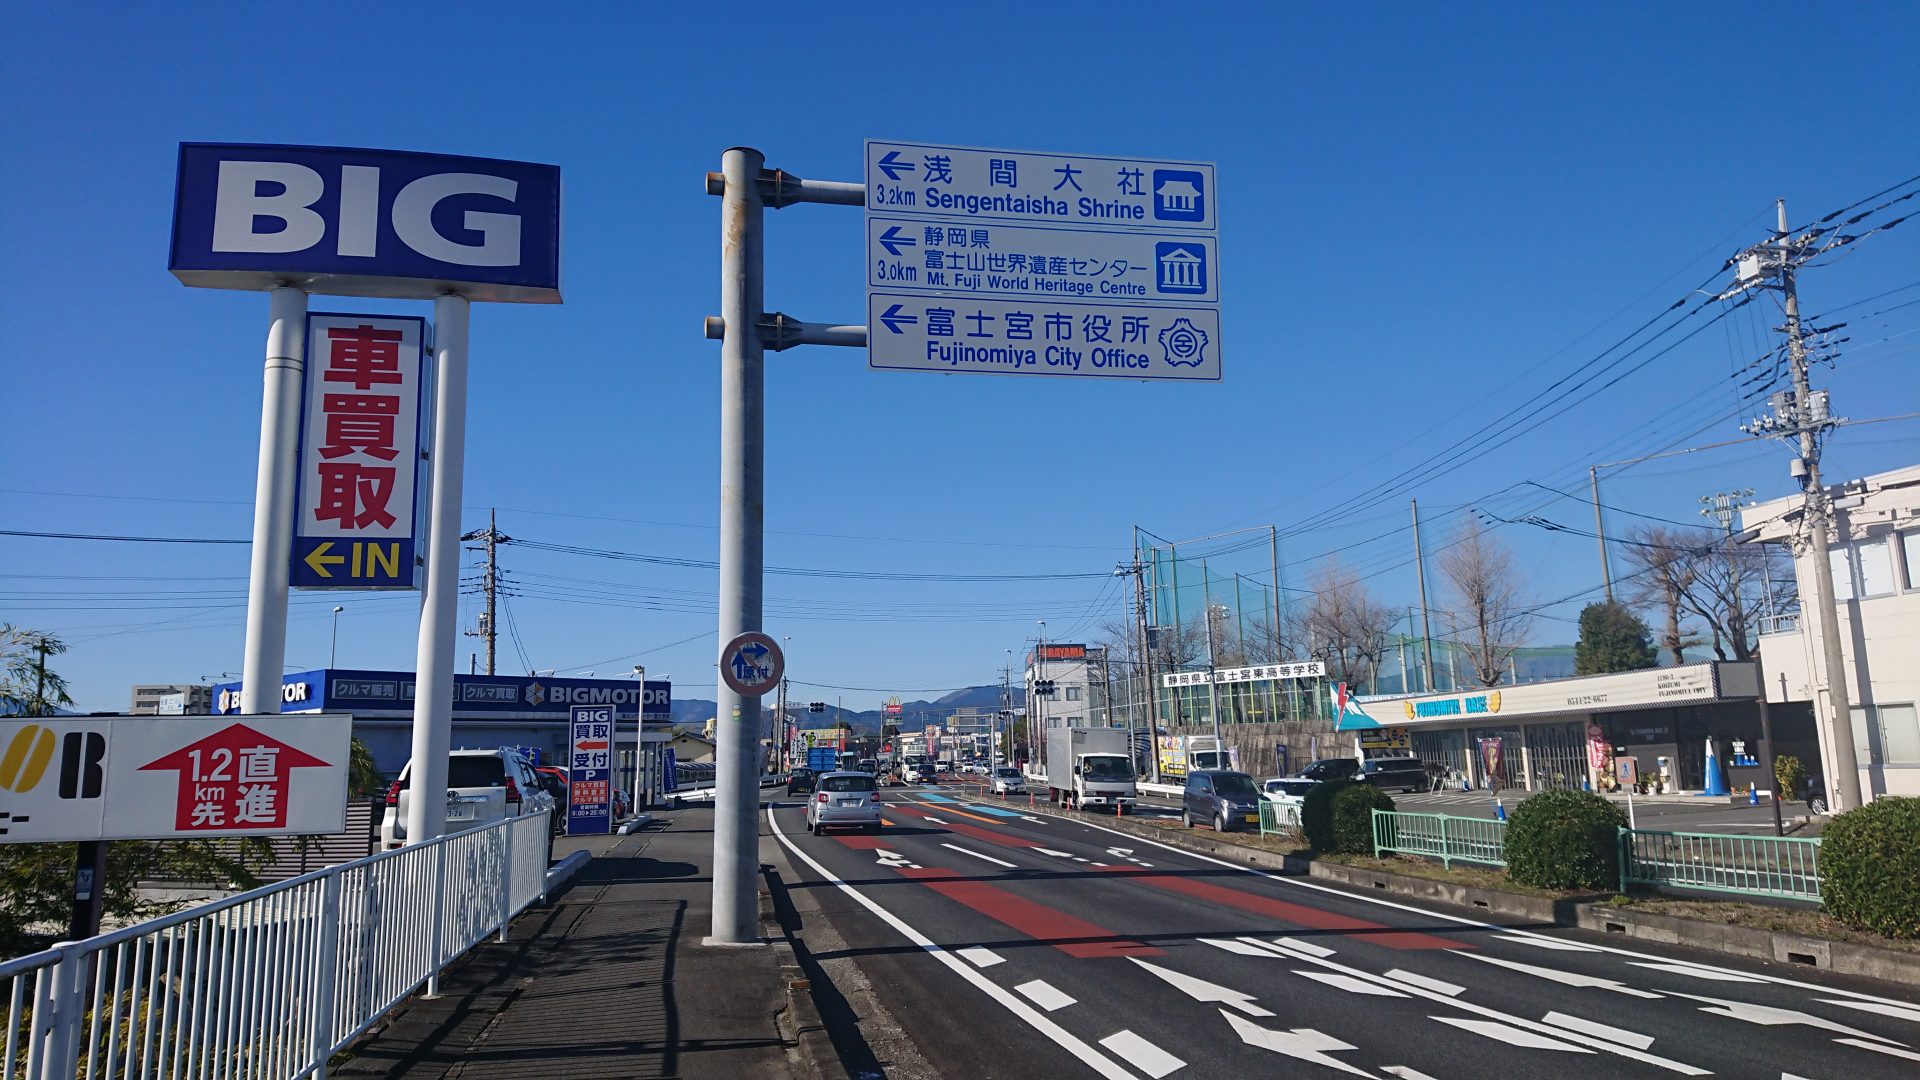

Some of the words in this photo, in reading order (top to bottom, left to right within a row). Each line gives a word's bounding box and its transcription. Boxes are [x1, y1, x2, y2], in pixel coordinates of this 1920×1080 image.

[923, 154, 1146, 196] 浅間大社
[876, 184, 915, 207] 3.2km
[925, 187, 1068, 217] Sengentaisha
[1078, 197, 1145, 220] Shrine
[212, 160, 521, 267] BIG
[924, 226, 989, 249] 静岡県
[877, 258, 917, 282] 3.0km
[924, 249, 1148, 278] 富士山世界遺産センター
[927, 273, 949, 288] Mt.
[954, 274, 981, 290] Fuji
[987, 276, 1029, 291] World
[1034, 277, 1094, 294] Heritage
[1100, 280, 1146, 296] Centre
[925, 306, 1150, 345] 富士宮市役所
[926, 341, 1036, 368] Fujinomiya
[1045, 346, 1083, 371] City
[1091, 347, 1150, 370] Office
[314, 324, 403, 530] 車買取
[351, 542, 400, 578] IN
[743, 665, 769, 679] 原付
[1167, 662, 1320, 686] 静岡県立富士宮東高等学校
[337, 682, 394, 698] クルマ販売
[466, 686, 516, 700] クルマ買取
[550, 686, 668, 705] BIGMOTOR
[1465, 695, 1488, 714] BASE
[576, 711, 608, 722] BIG
[575, 724, 609, 739] 買取
[188, 747, 233, 783] 1.2
[574, 752, 608, 768] 受付
[233, 744, 280, 825] 直進
[585, 770, 596, 781] P
[194, 783, 225, 801] km
[190, 802, 226, 827] 先
